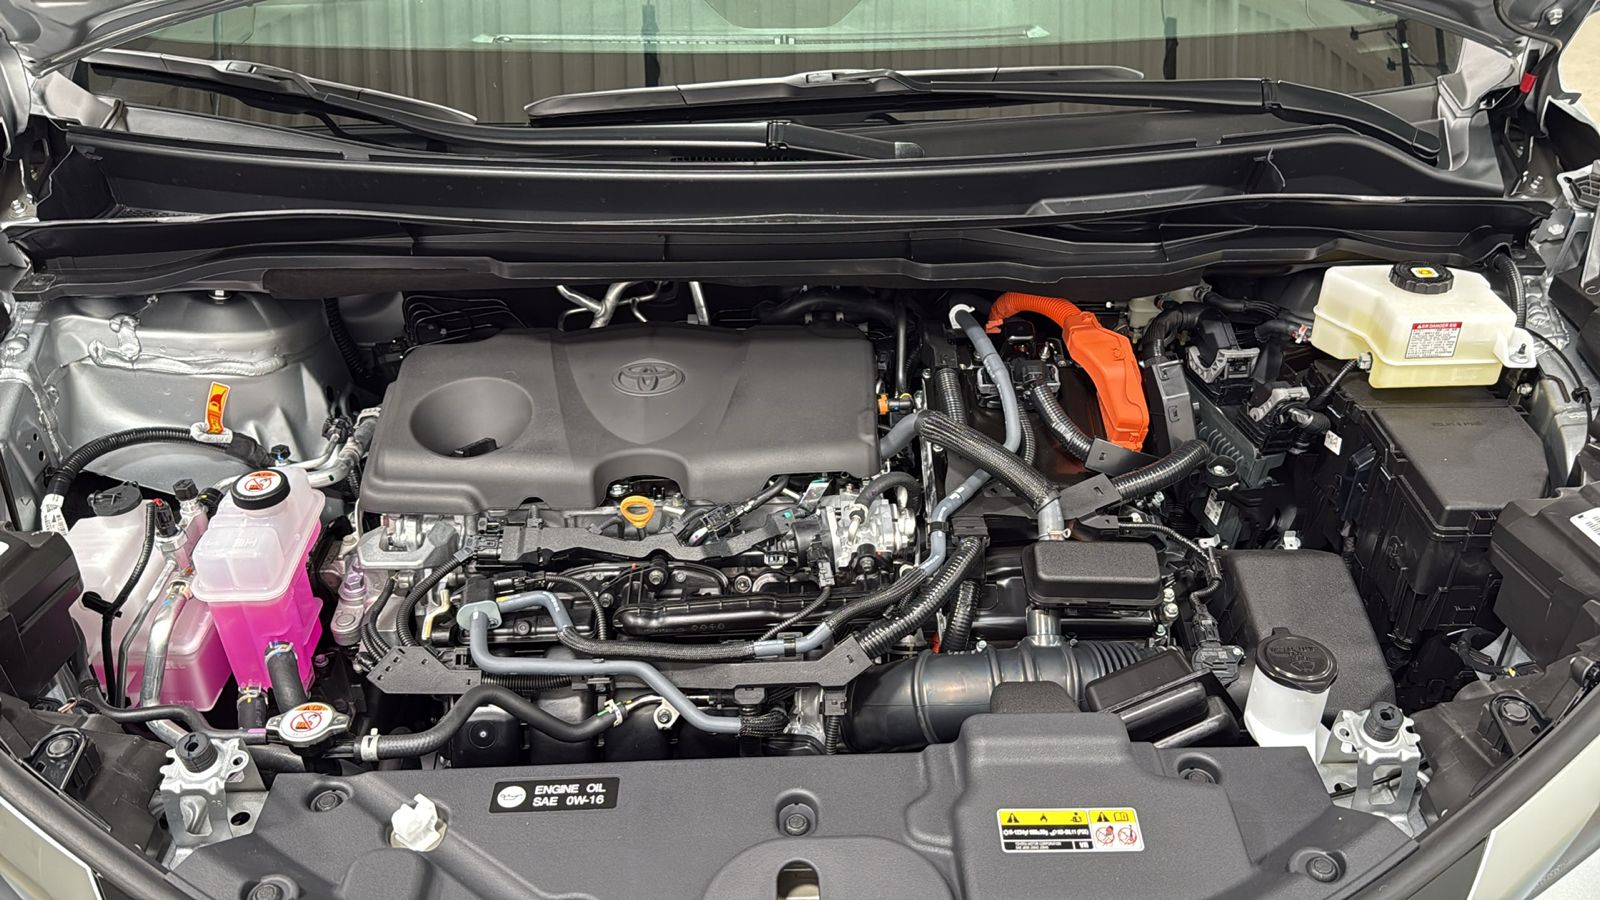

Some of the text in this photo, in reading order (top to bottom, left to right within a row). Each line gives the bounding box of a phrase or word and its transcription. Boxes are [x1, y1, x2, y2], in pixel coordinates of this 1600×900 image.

[534, 783, 606, 794] ENGINE OIL
[532, 795, 604, 807] SAE 0W-16
